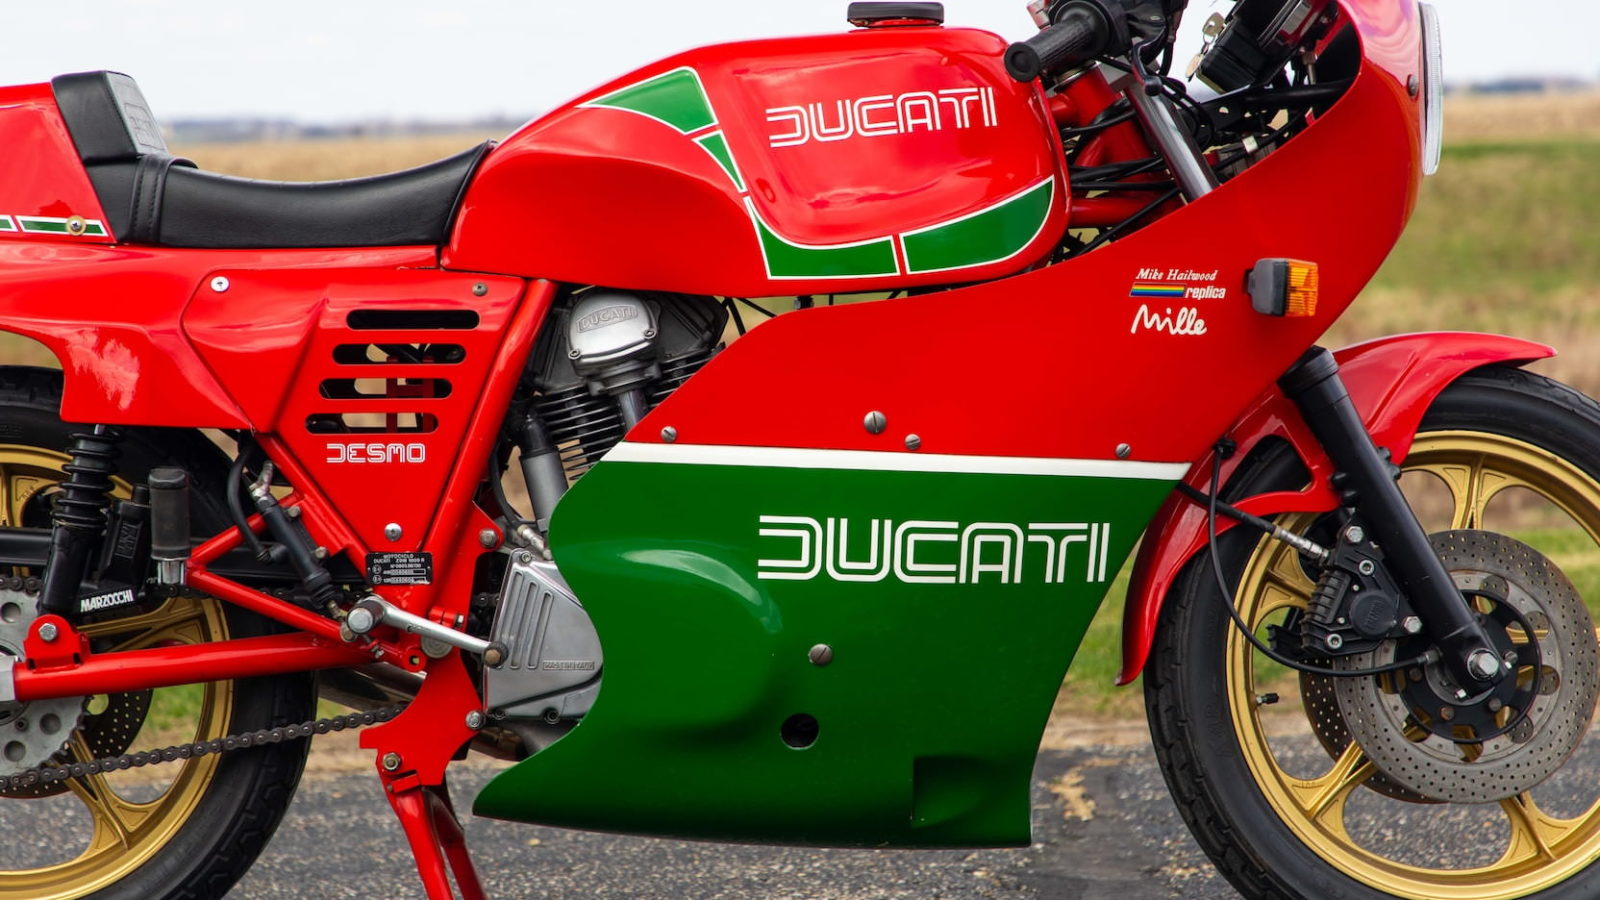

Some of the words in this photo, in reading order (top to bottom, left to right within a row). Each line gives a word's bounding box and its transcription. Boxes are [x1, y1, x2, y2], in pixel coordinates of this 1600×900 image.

[765, 86, 998, 148] DUCATI
[1135, 268, 1164, 280] Mike
[1166, 268, 1219, 281] Hailwood
[1185, 285, 1227, 300] replica
[581, 306, 638, 329] DUCATI
[1130, 304, 1208, 335] Mille
[326, 443, 426, 463] DESMO
[757, 515, 1110, 584] DUCATI
[80, 589, 134, 613] MARZOCCHI
